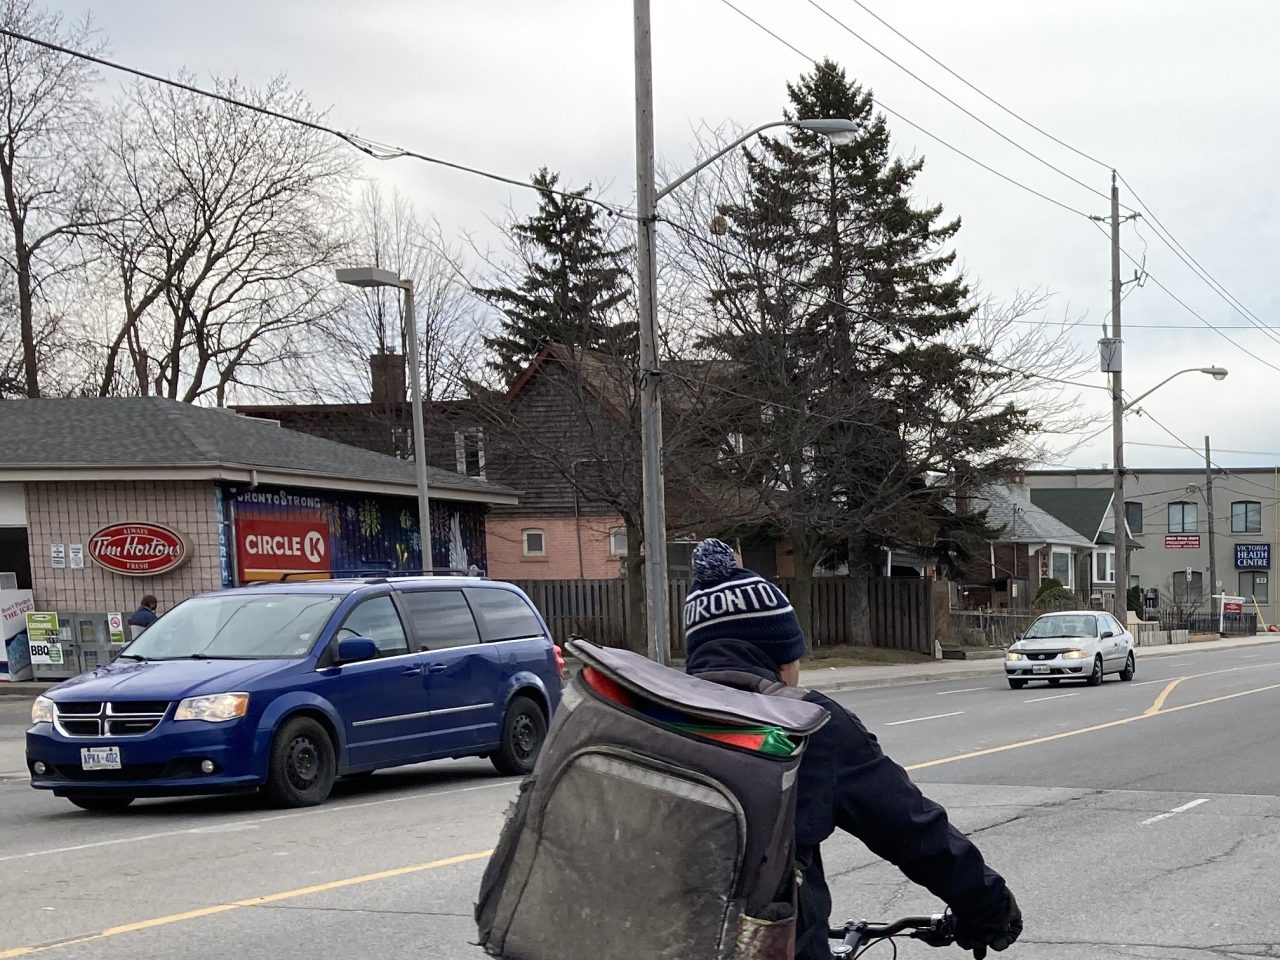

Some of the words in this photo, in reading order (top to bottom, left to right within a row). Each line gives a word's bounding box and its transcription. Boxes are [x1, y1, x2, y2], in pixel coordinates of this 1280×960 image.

[93, 536, 120, 556] Tim
[123, 536, 180, 556] Hortons
[245, 534, 301, 556] CIRCLE
[307, 535, 325, 561] K
[1238, 551, 1267, 559] HEALTH
[1, 603, 15, 614] Don't
[3, 609, 19, 621] THE
[31, 645, 49, 656] BBQ
